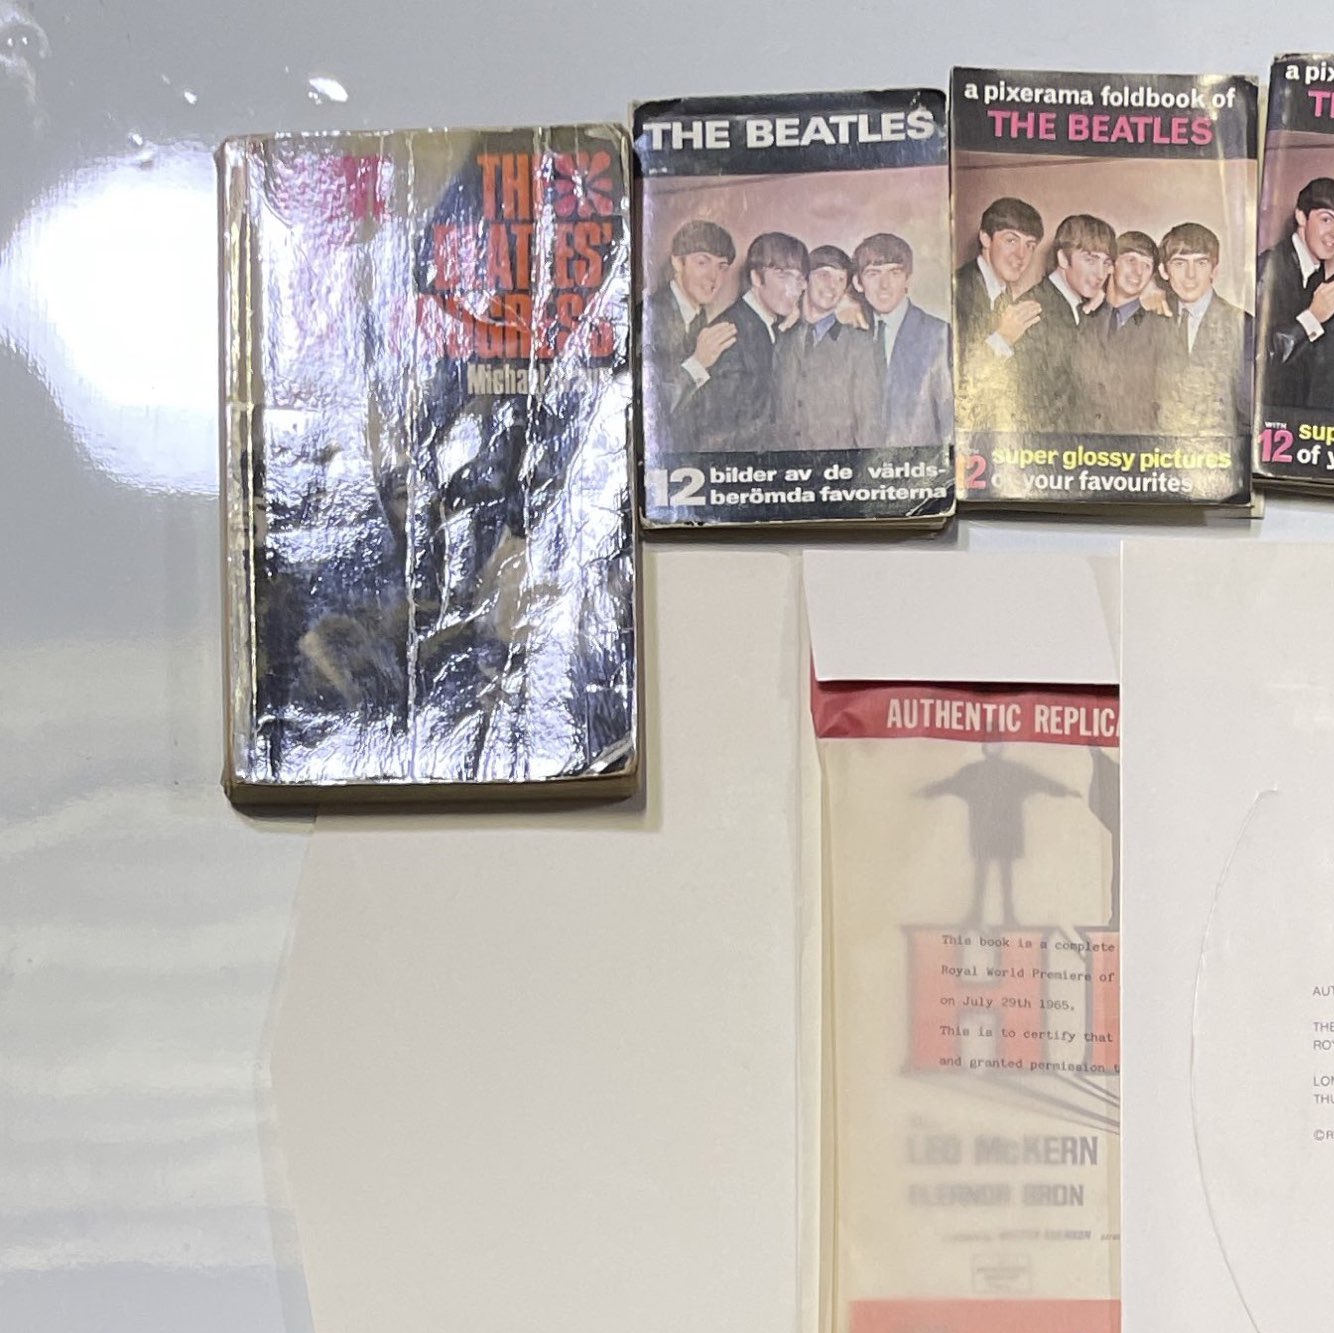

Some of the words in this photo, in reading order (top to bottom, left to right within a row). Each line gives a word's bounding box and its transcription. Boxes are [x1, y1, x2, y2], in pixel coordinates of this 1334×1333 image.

[965, 84, 979, 100] a
[984, 81, 1093, 106] pixerama
[1101, 86, 1204, 108] foldbook
[1212, 87, 1236, 108] of
[642, 122, 731, 151] THE
[746, 111, 935, 149] BEATLES
[988, 109, 1056, 140] THE
[1068, 113, 1214, 145] BEATLES
[646, 468, 706, 508] 12
[710, 467, 776, 485] bilder
[784, 470, 811, 484] av
[824, 466, 854, 481] de
[869, 462, 947, 481] världs-
[710, 484, 816, 506] berömda
[821, 484, 948, 501] favoriterna
[886, 698, 1022, 732] AUTHENTIC
[940, 994, 956, 1007] on
[961, 996, 993, 1011] July
